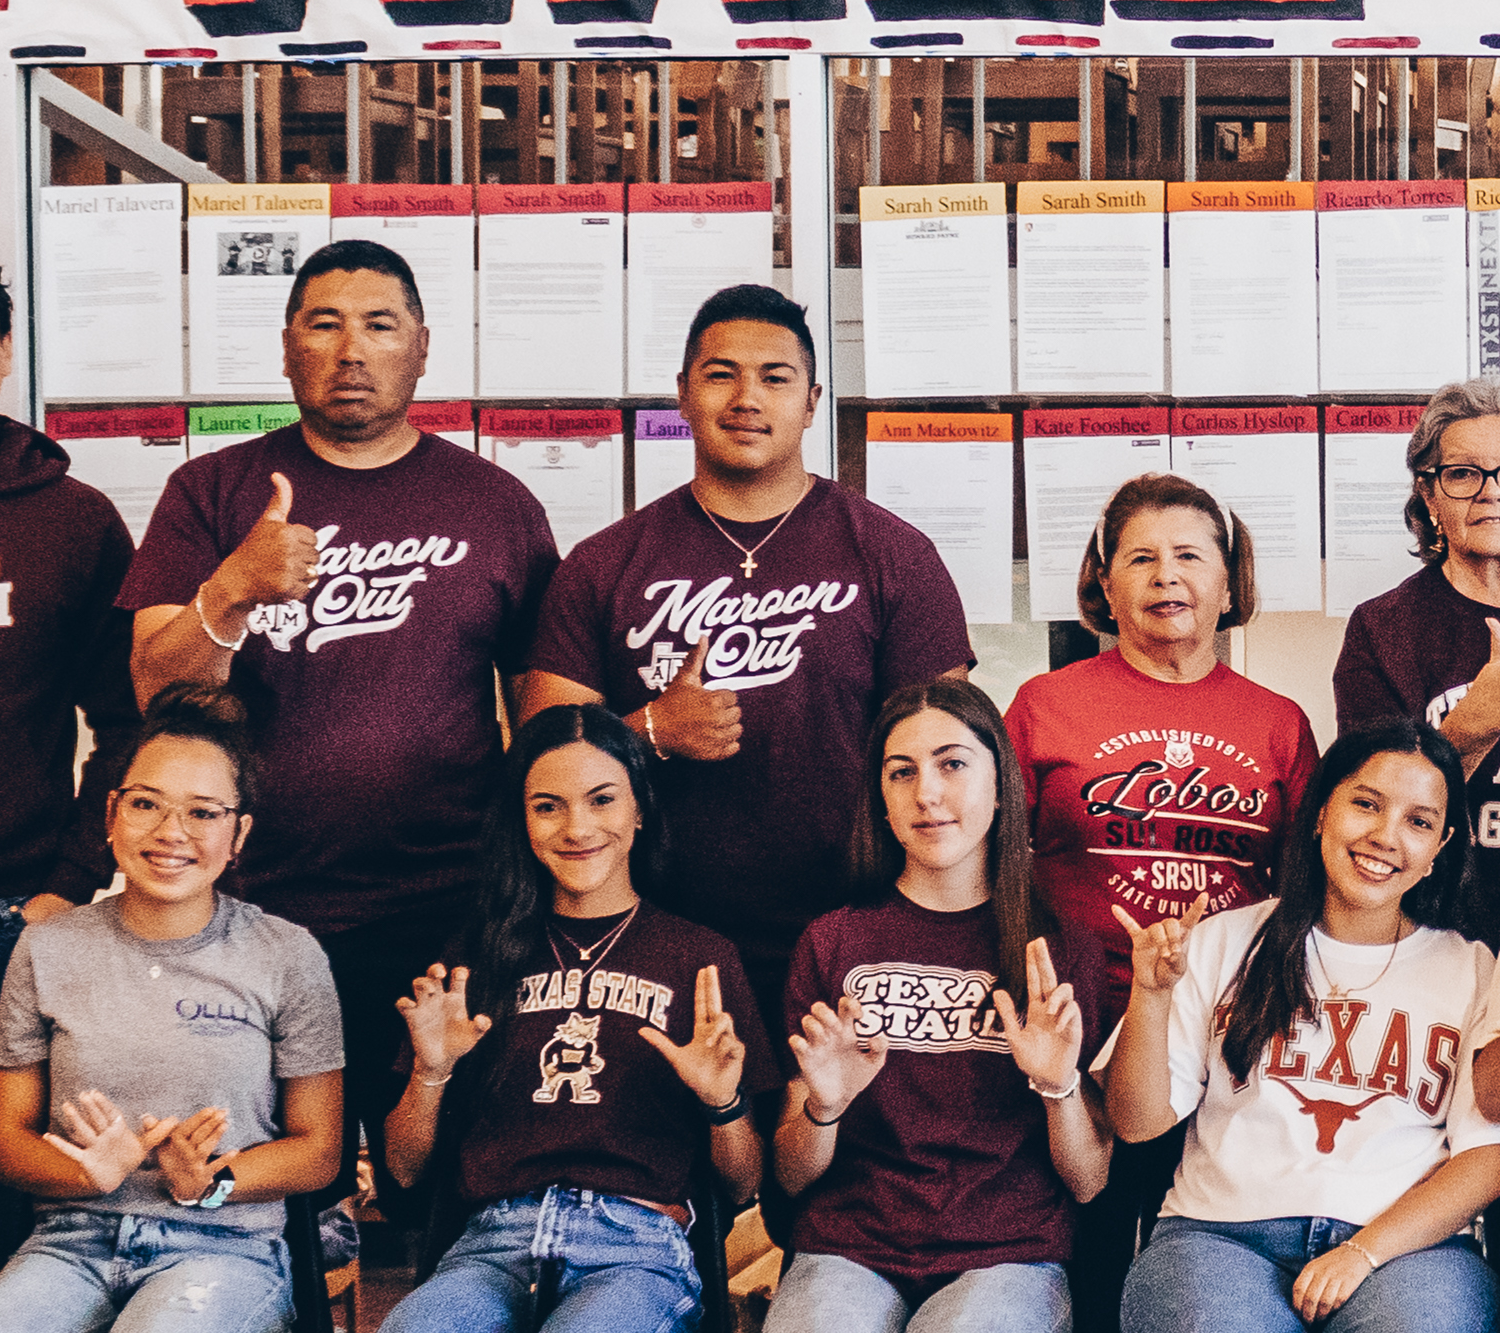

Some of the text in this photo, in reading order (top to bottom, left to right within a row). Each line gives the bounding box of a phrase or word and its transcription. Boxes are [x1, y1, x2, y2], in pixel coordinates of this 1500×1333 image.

[44, 197, 175, 215] Mariel Talavera
[192, 194, 324, 212] Mariel Talavera
[503, 190, 607, 208] Sarah Smith
[651, 190, 755, 208] Sarah Smith
[884, 195, 989, 215] Sarah Smith
[1042, 191, 1146, 210] Sarah Smith
[1190, 190, 1296, 208] Sarah Smith
[1325, 189, 1455, 209] Ricardo Torres
[198, 416, 251, 433] Laurie
[1033, 417, 1151, 435] Kate Fooshee
[1181, 412, 1305, 435] Carlos Hyslop
[1335, 409, 1392, 428] Carlos
[880, 422, 1000, 438] Ann Markowitz
[306, 567, 428, 654] Out
[626, 576, 859, 649] Maroon
[703, 614, 816, 691] Out
[1098, 728, 1256, 769] ESTABLISHED 1917
[1080, 758, 1269, 822] Lobos
[1105, 820, 1252, 859] SUL ROSS
[1150, 859, 1207, 892] SRSU
[1107, 873, 1155, 911] STATE
[586, 969, 674, 1032] STATE
[856, 972, 988, 1009] TEXA
